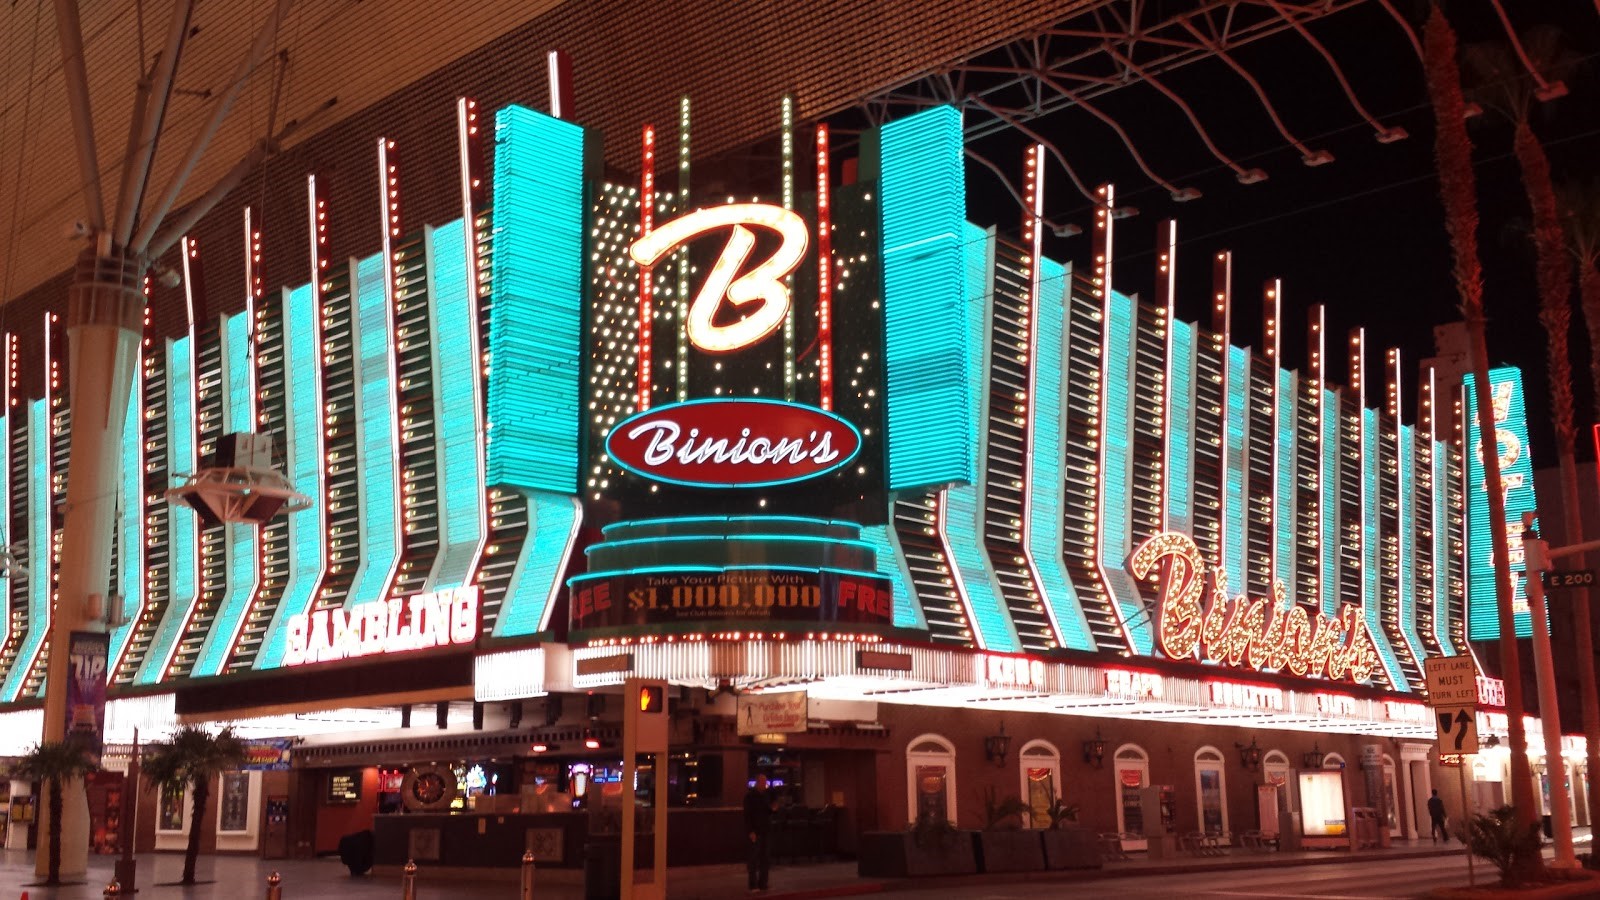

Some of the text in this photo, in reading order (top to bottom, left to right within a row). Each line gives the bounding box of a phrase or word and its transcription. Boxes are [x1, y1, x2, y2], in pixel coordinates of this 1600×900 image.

[629, 203, 810, 352] B
[628, 420, 839, 466] Binion's
[646, 574, 805, 587] Take Your Picture With
[1551, 573, 1593, 586] E 200
[628, 585, 821, 611] $1,000,000
[1130, 531, 1374, 684] Binion's
[283, 585, 479, 667] GAMBLING
[1429, 661, 1471, 672] LEFT LANE
[1438, 675, 1464, 686] MUST
[1432, 689, 1474, 699] TURN LEFT
